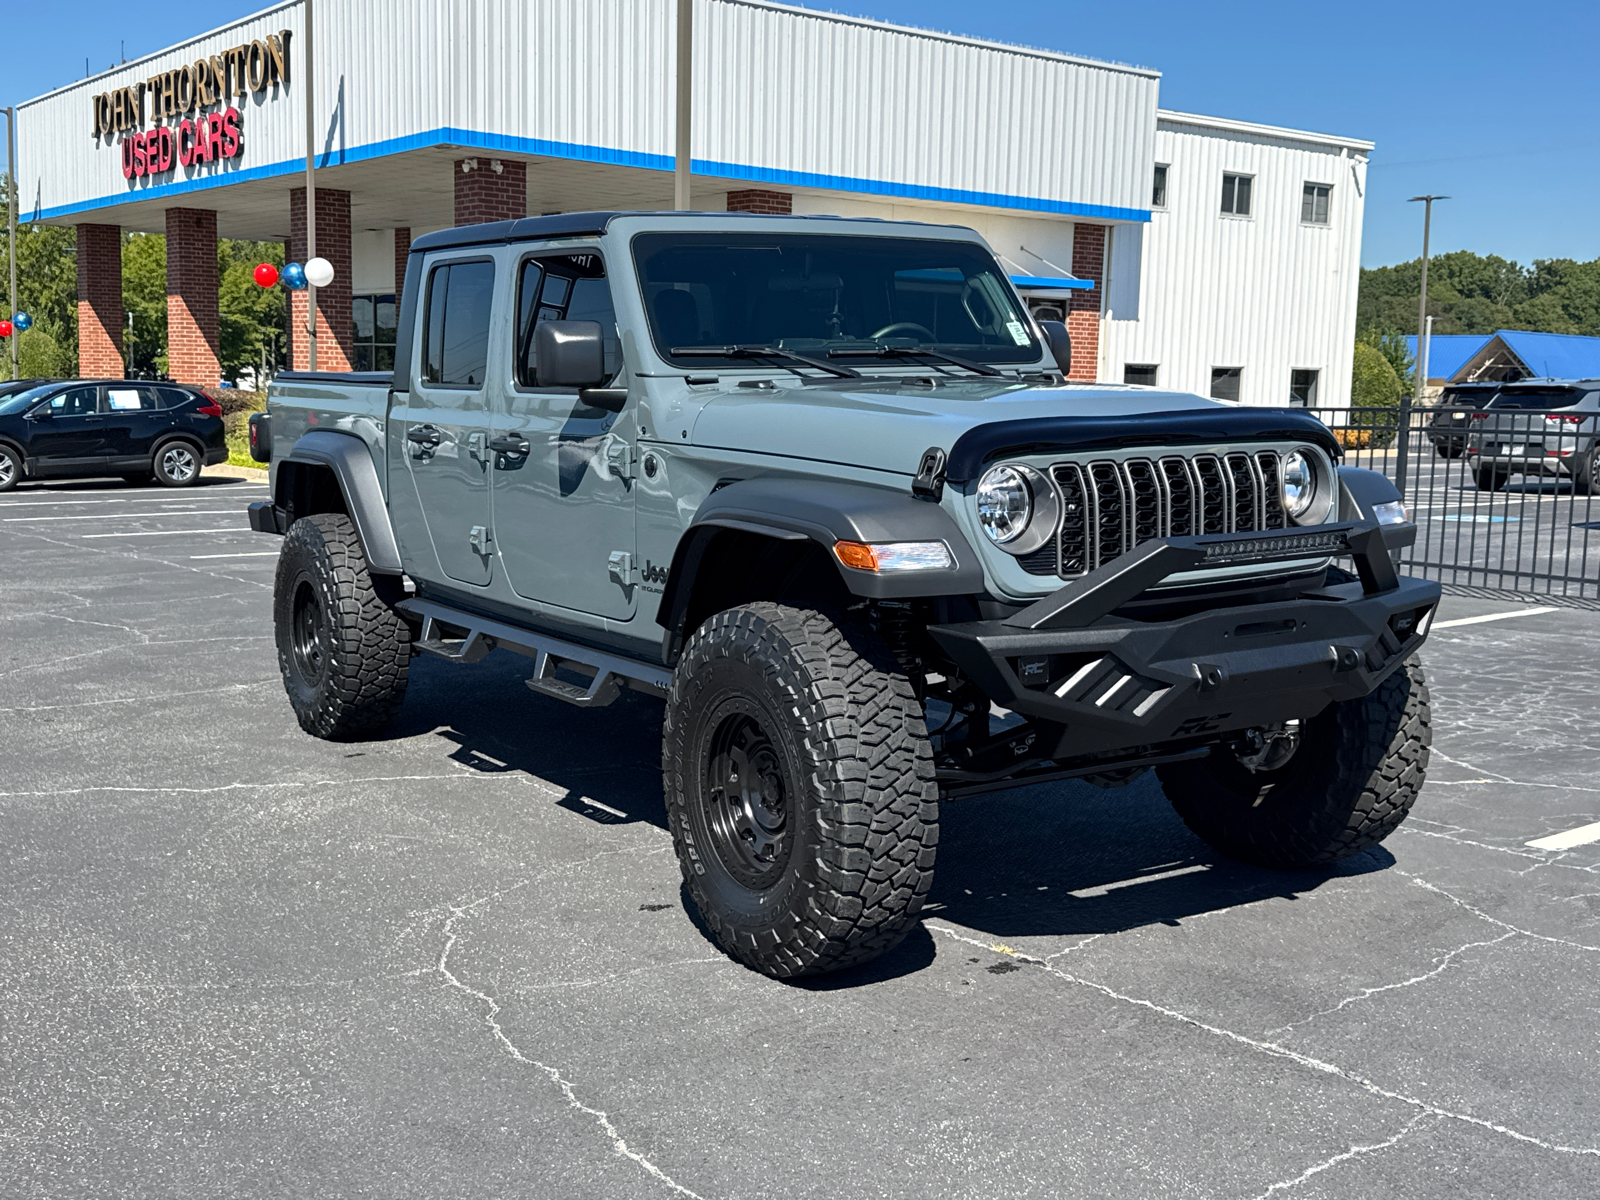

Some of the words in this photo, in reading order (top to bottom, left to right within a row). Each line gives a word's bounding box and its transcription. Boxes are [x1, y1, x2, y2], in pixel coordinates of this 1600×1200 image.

[92, 82, 146, 138] JOHN
[147, 29, 293, 121] THORNTON
[121, 126, 175, 179] USED
[179, 106, 243, 167] CARS
[641, 559, 669, 585] Jee
[679, 812, 705, 876] OPEN
